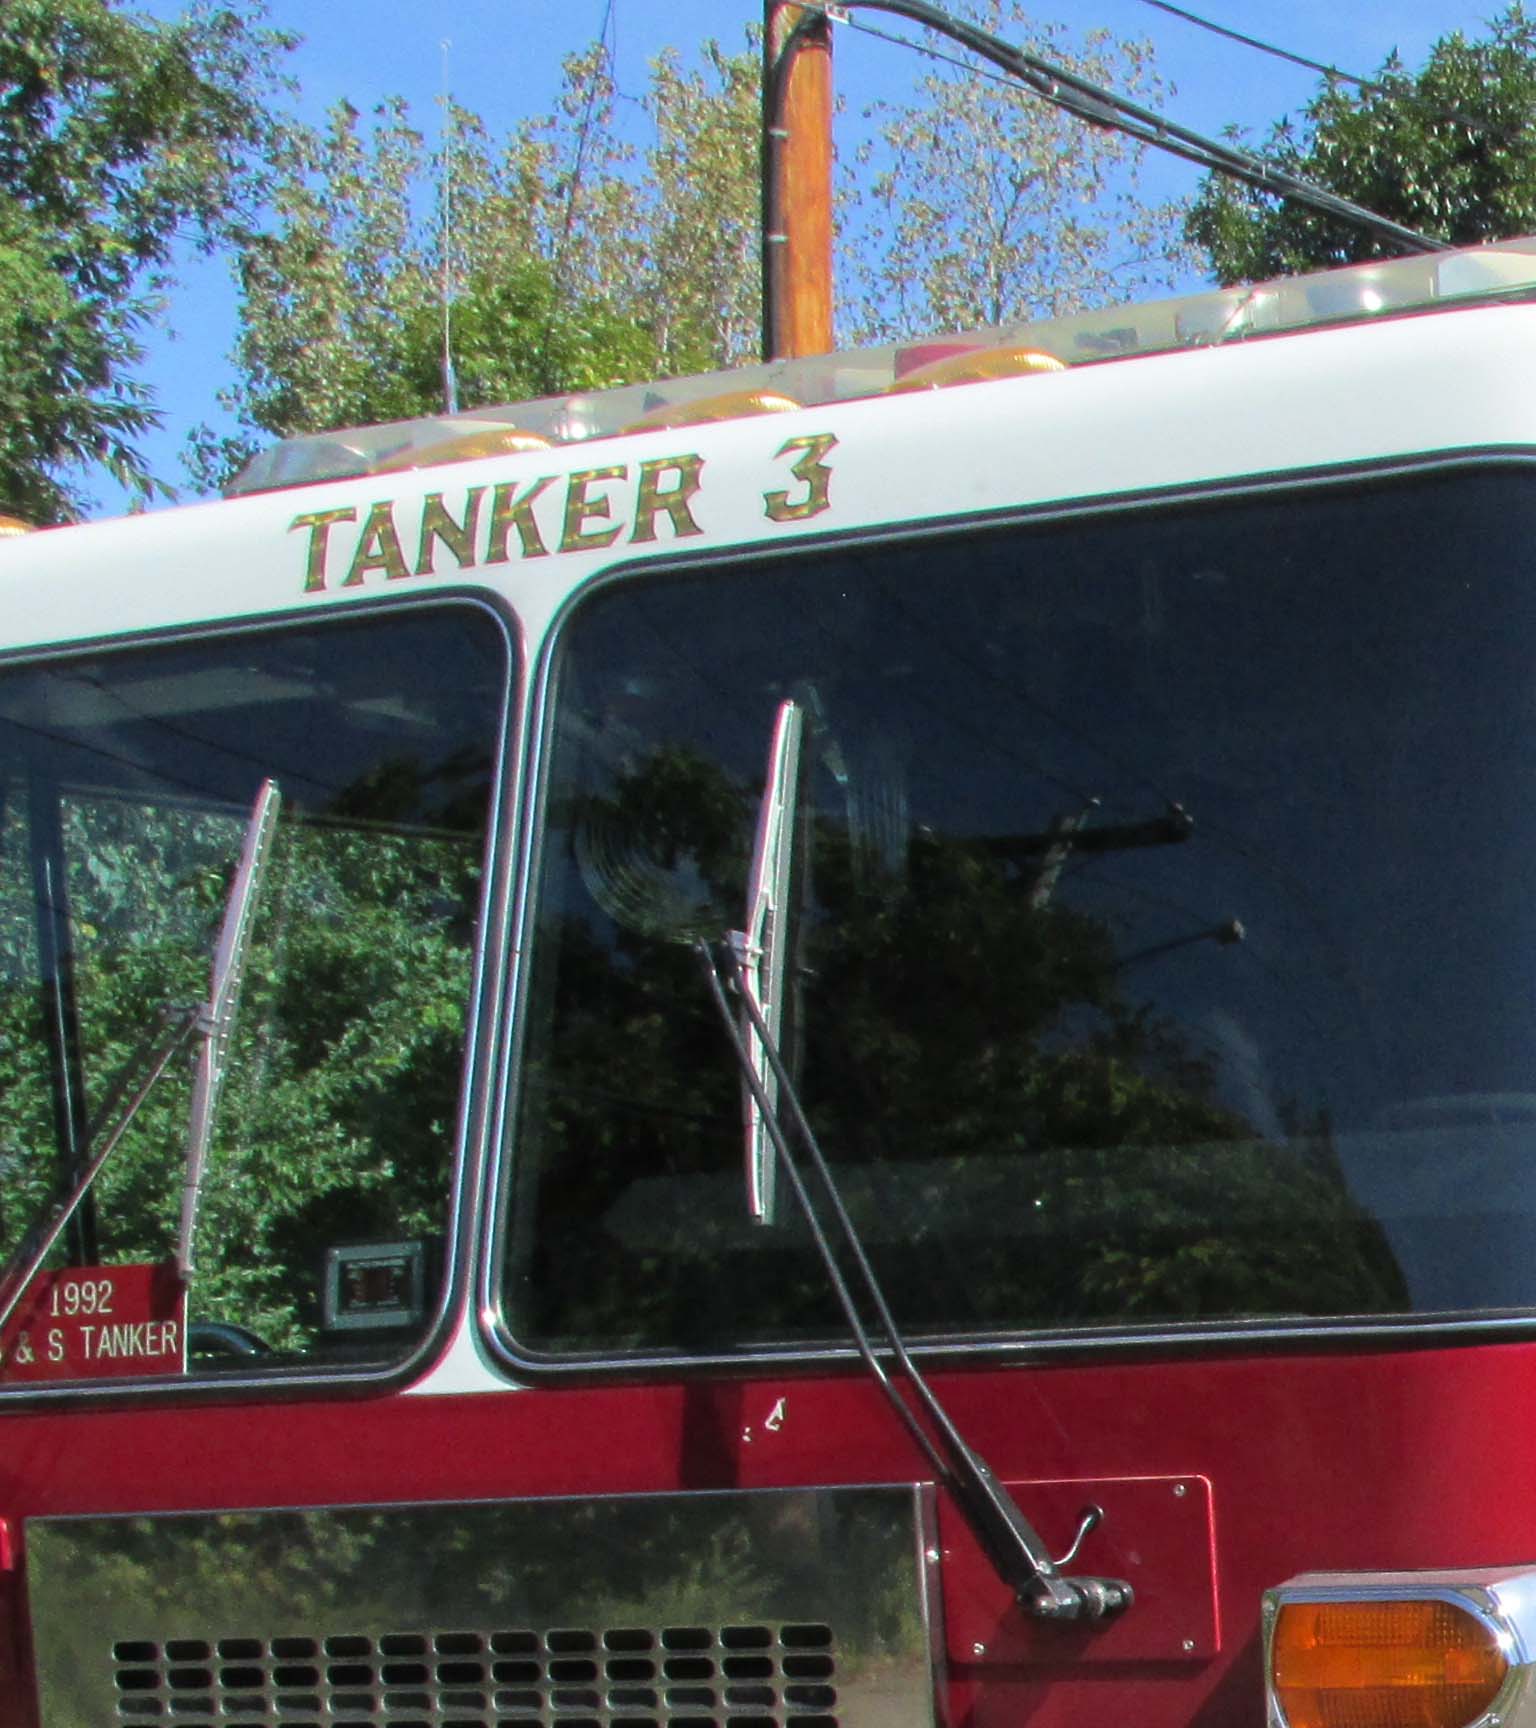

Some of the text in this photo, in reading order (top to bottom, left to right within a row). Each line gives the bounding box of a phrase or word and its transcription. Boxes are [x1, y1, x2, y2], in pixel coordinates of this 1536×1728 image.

[288, 432, 840, 594] TANKER 3
[50, 1280, 113, 1317] 1992
[15, 1331, 35, 1365] &
[48, 1329, 64, 1362] S
[80, 1320, 178, 1359] TANKER
